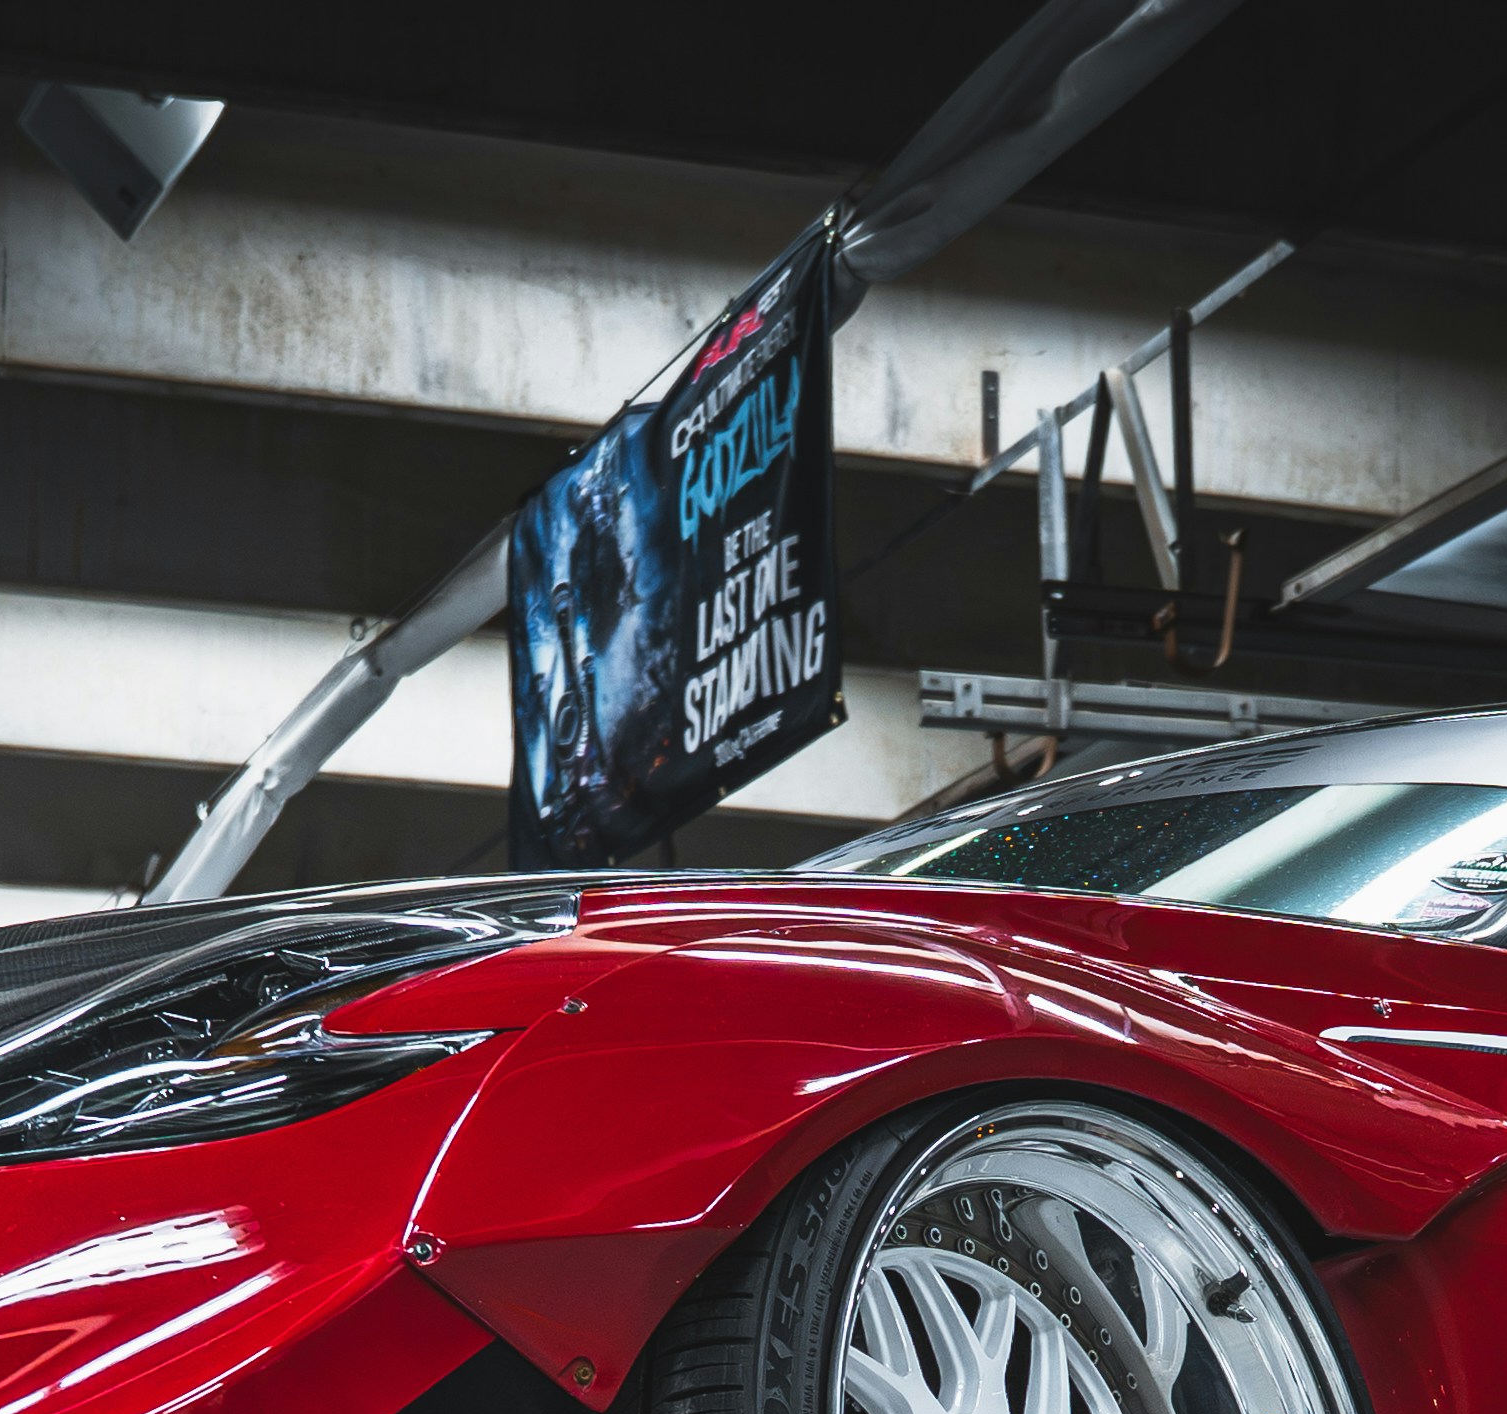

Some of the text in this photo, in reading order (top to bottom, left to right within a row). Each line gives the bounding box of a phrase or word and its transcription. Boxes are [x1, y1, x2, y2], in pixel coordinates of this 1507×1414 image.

[724, 508, 772, 573] BE THE
[697, 569, 752, 663] LAST
